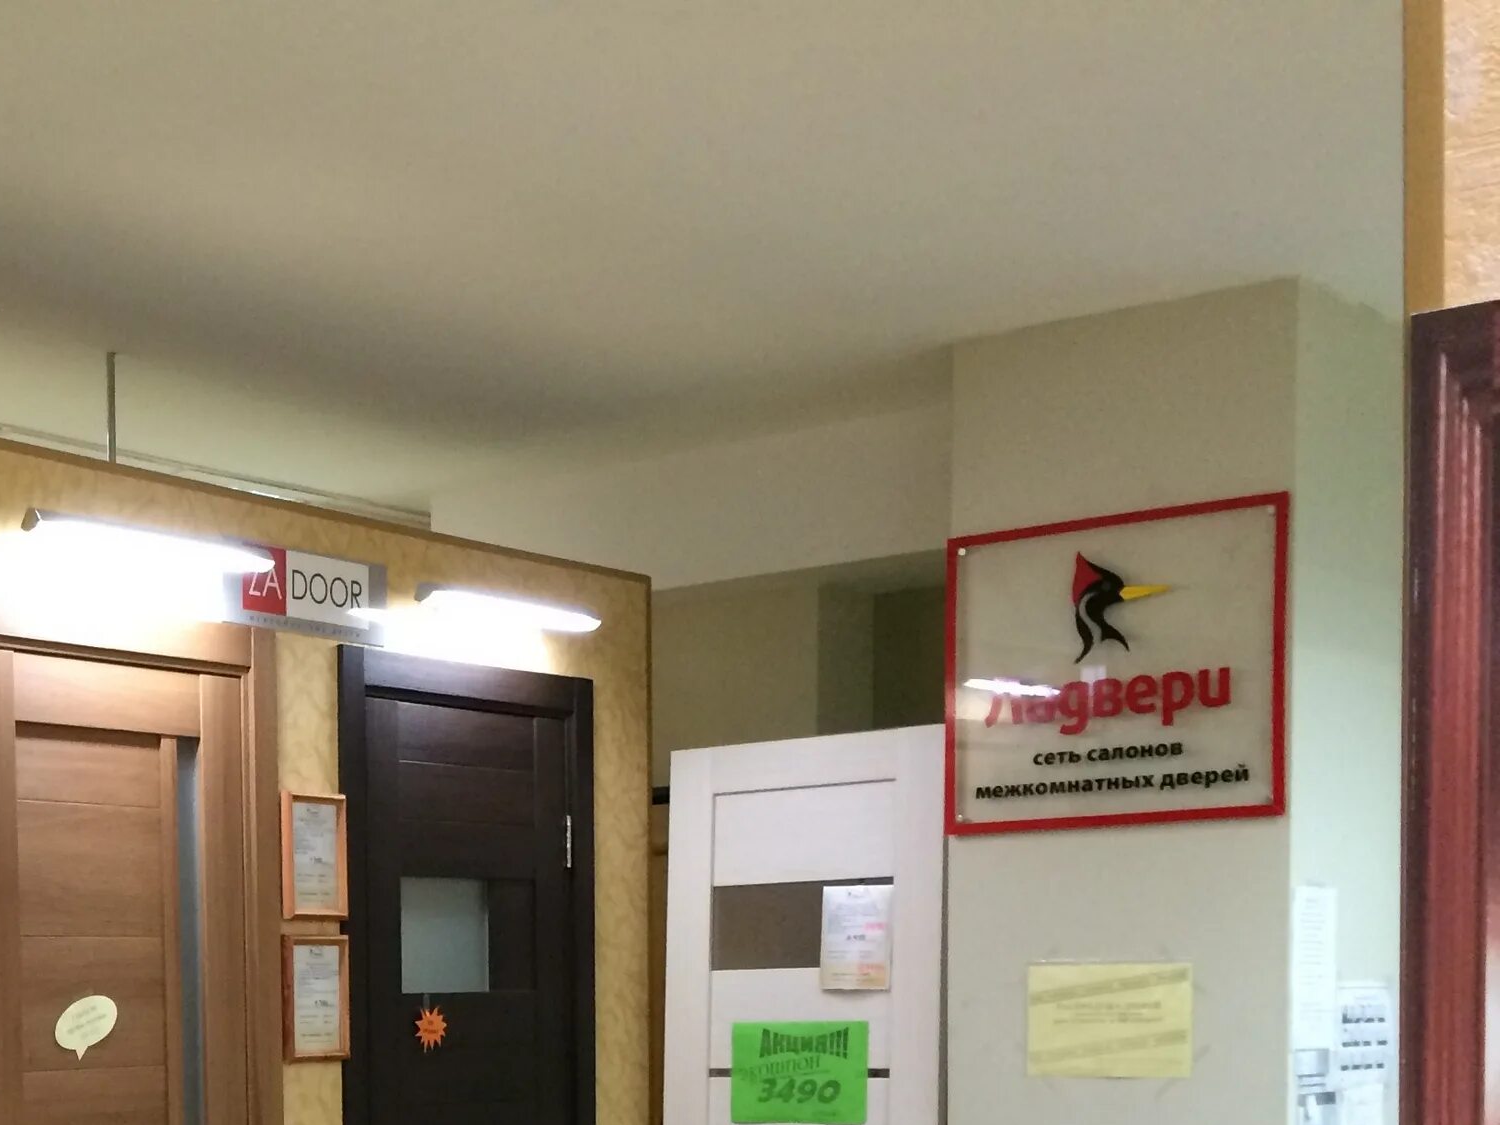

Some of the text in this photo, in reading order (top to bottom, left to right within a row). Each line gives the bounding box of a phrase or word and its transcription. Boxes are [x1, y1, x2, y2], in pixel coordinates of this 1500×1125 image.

[291, 569, 363, 609] DOOR
[1032, 740, 1184, 767] сеть салонов
[975, 763, 1251, 801] межкомнатных дверей
[757, 1077, 842, 1105] 3490
